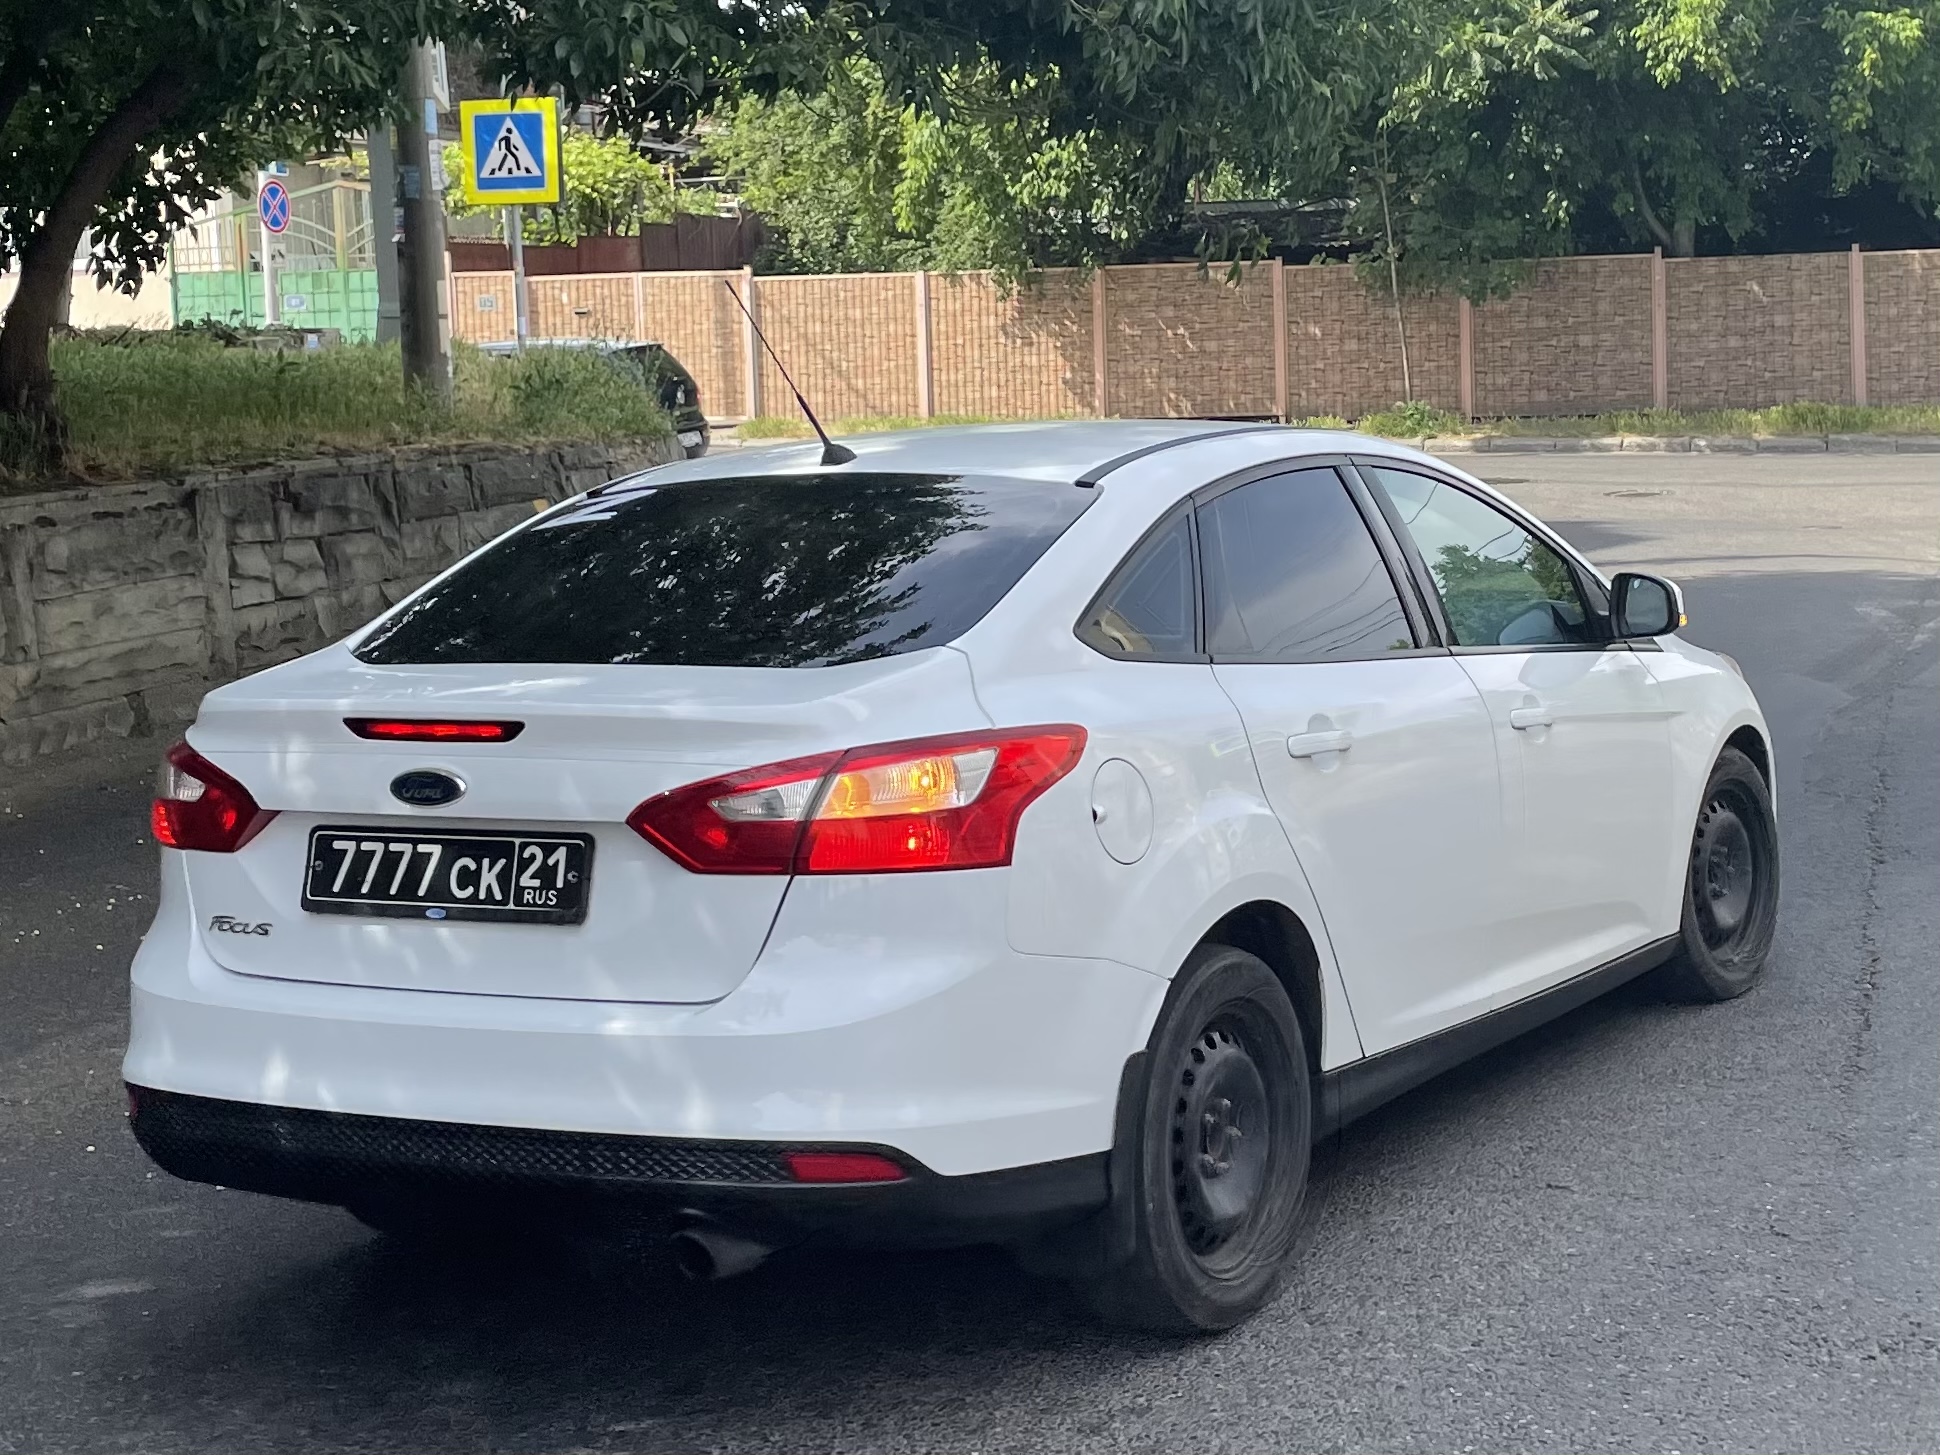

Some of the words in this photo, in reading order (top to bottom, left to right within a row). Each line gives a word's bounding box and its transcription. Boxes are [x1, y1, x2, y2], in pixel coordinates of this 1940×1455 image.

[332, 840, 442, 896] 7777
[450, 856, 507, 901] CK
[519, 844, 568, 888] 21
[523, 889, 558, 906] RUS
